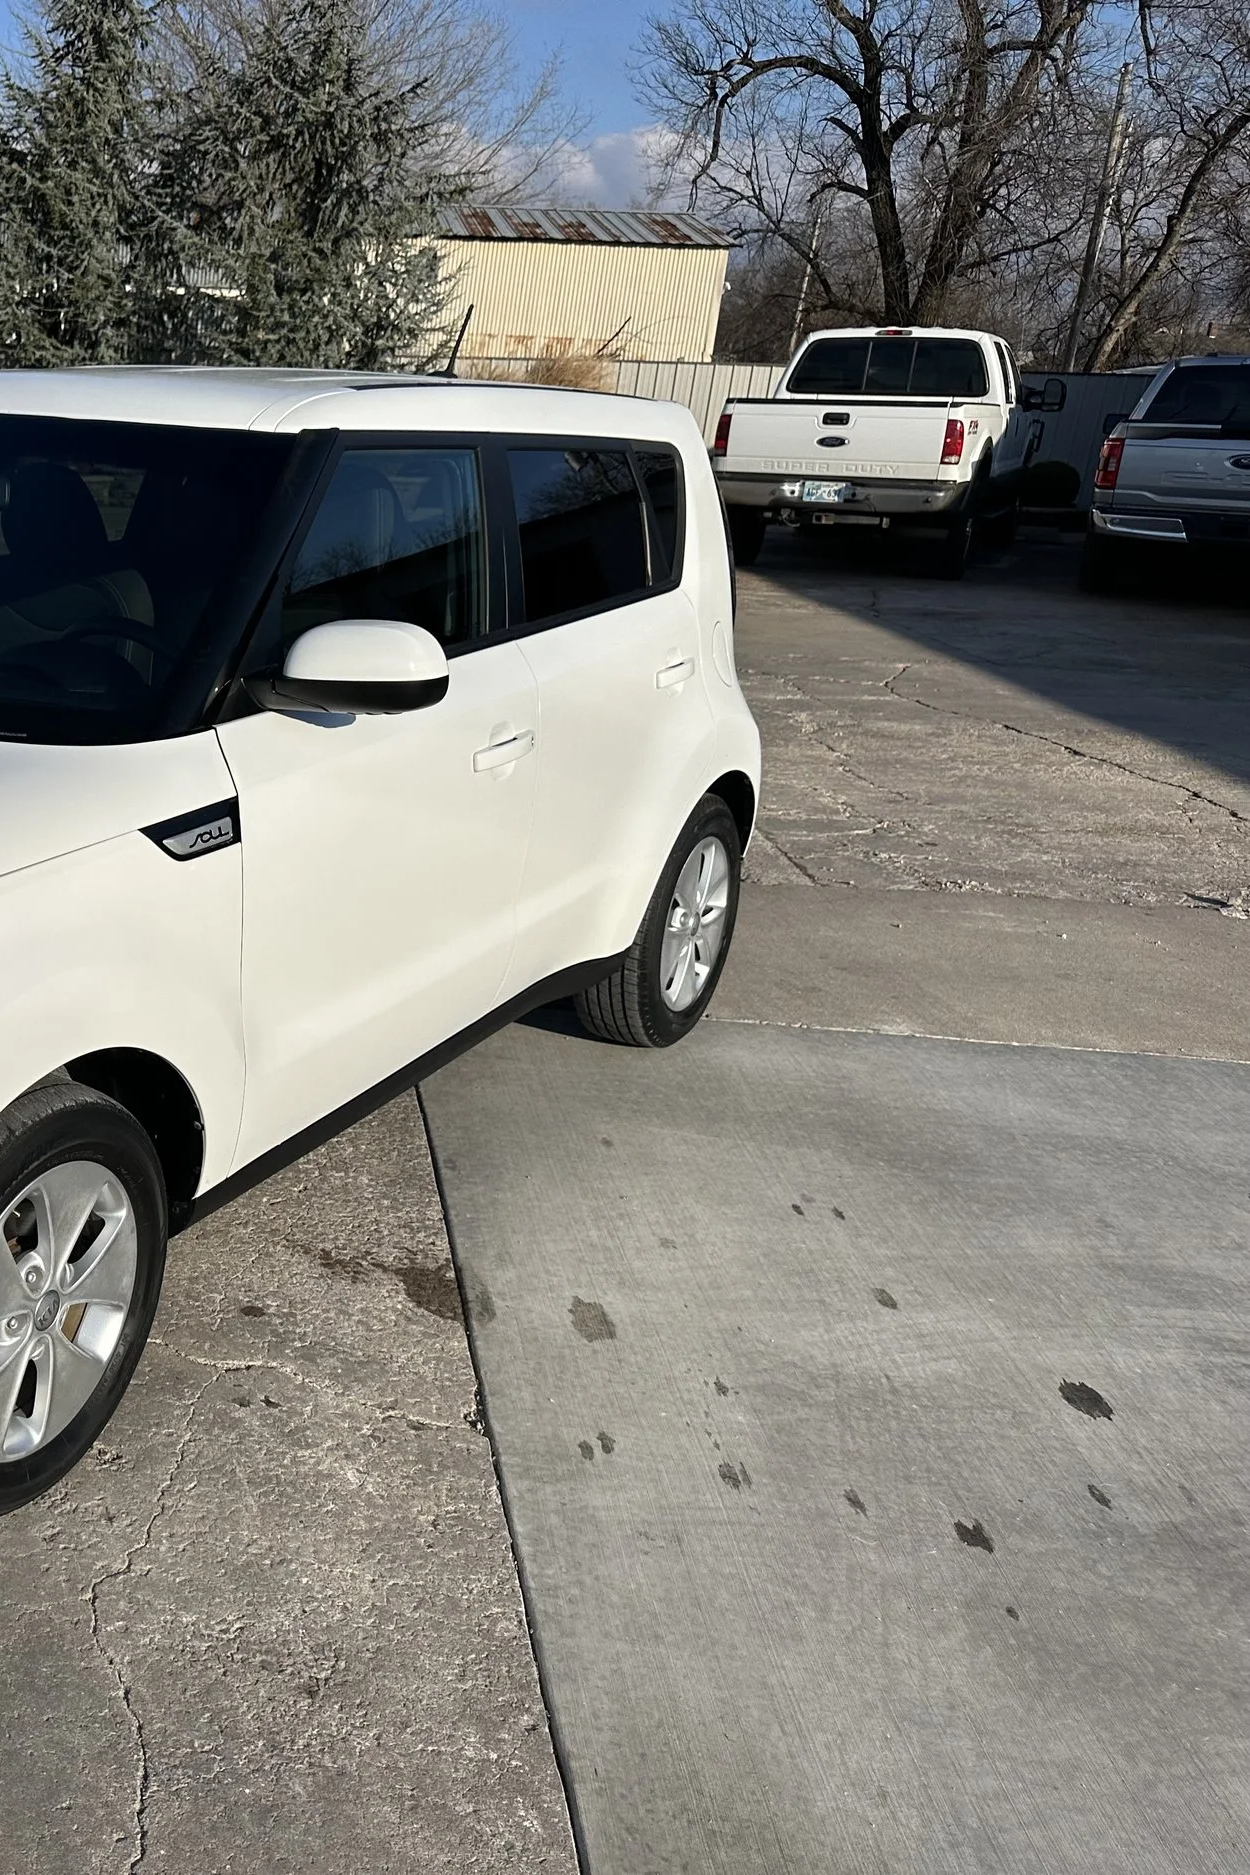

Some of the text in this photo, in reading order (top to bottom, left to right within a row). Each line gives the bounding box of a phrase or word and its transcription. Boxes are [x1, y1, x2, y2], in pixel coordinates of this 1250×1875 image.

[761, 460, 900, 476] SUPER DUTY
[38, 1299, 58, 1326] KIA
